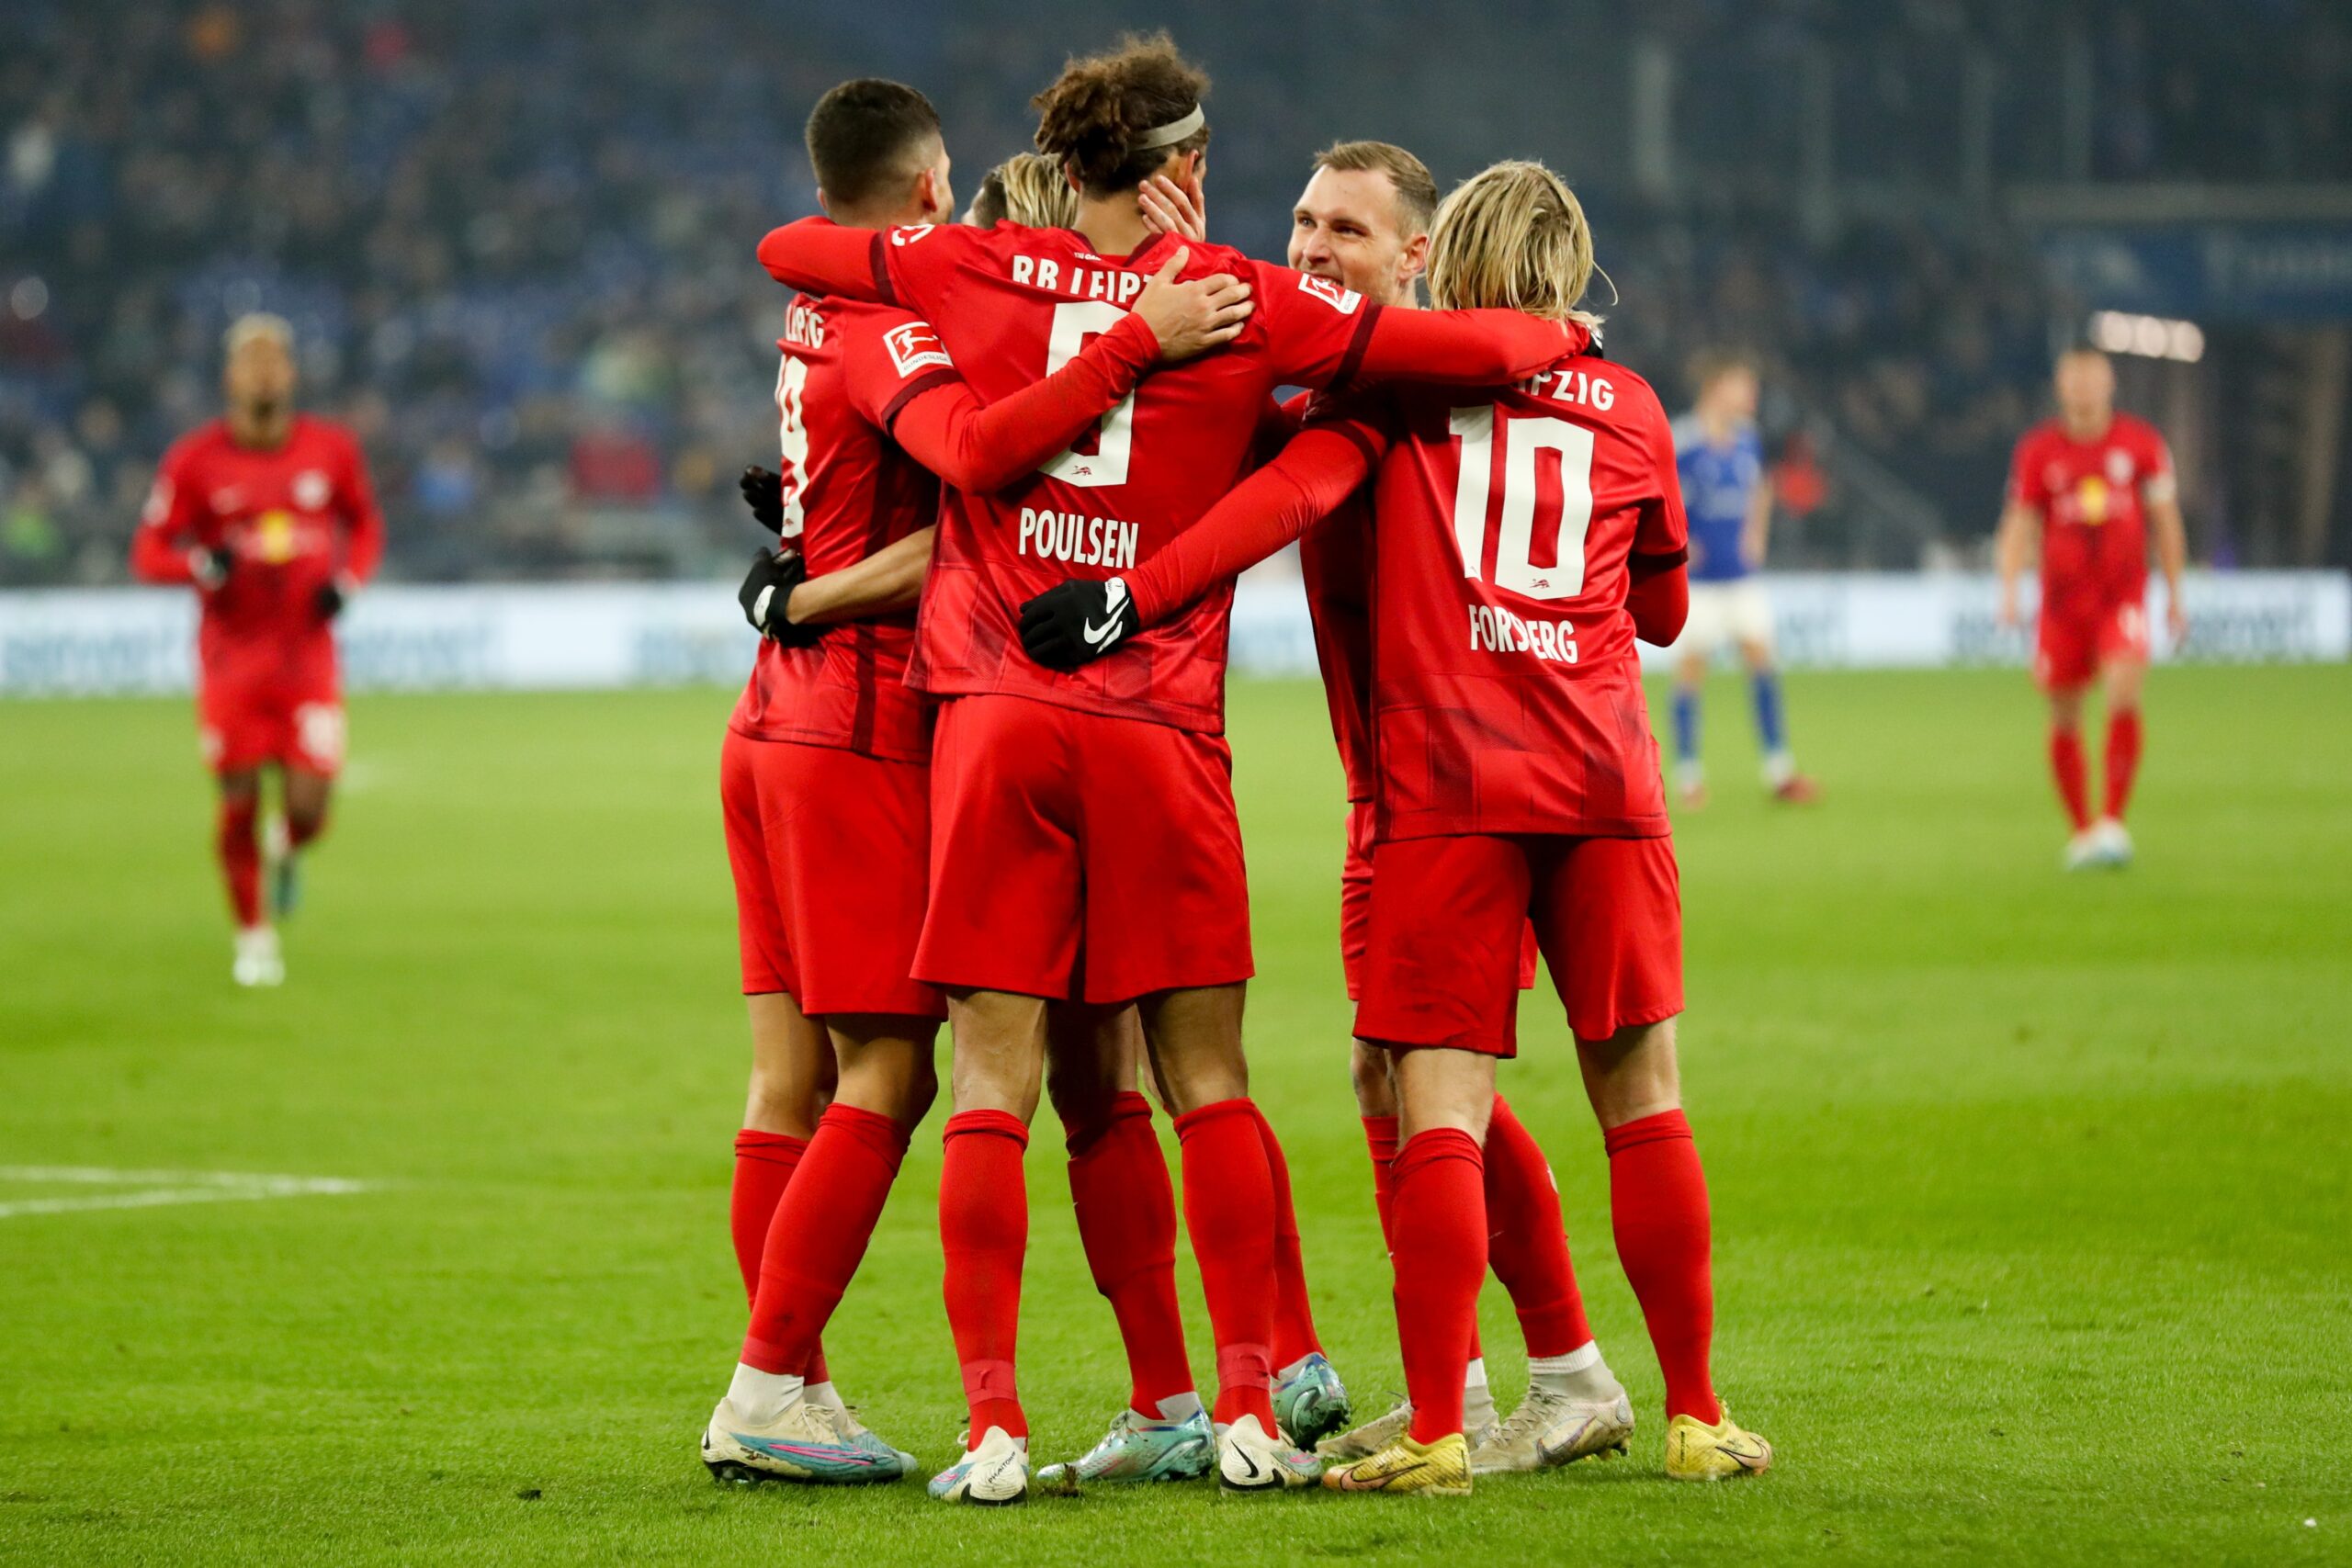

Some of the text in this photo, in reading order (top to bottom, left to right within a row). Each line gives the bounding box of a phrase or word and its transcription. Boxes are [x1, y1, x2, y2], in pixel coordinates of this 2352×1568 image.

[1449, 404, 1595, 601] 10
[1019, 507, 1139, 570] POULSEN
[1468, 604, 1578, 664] FORSERG
